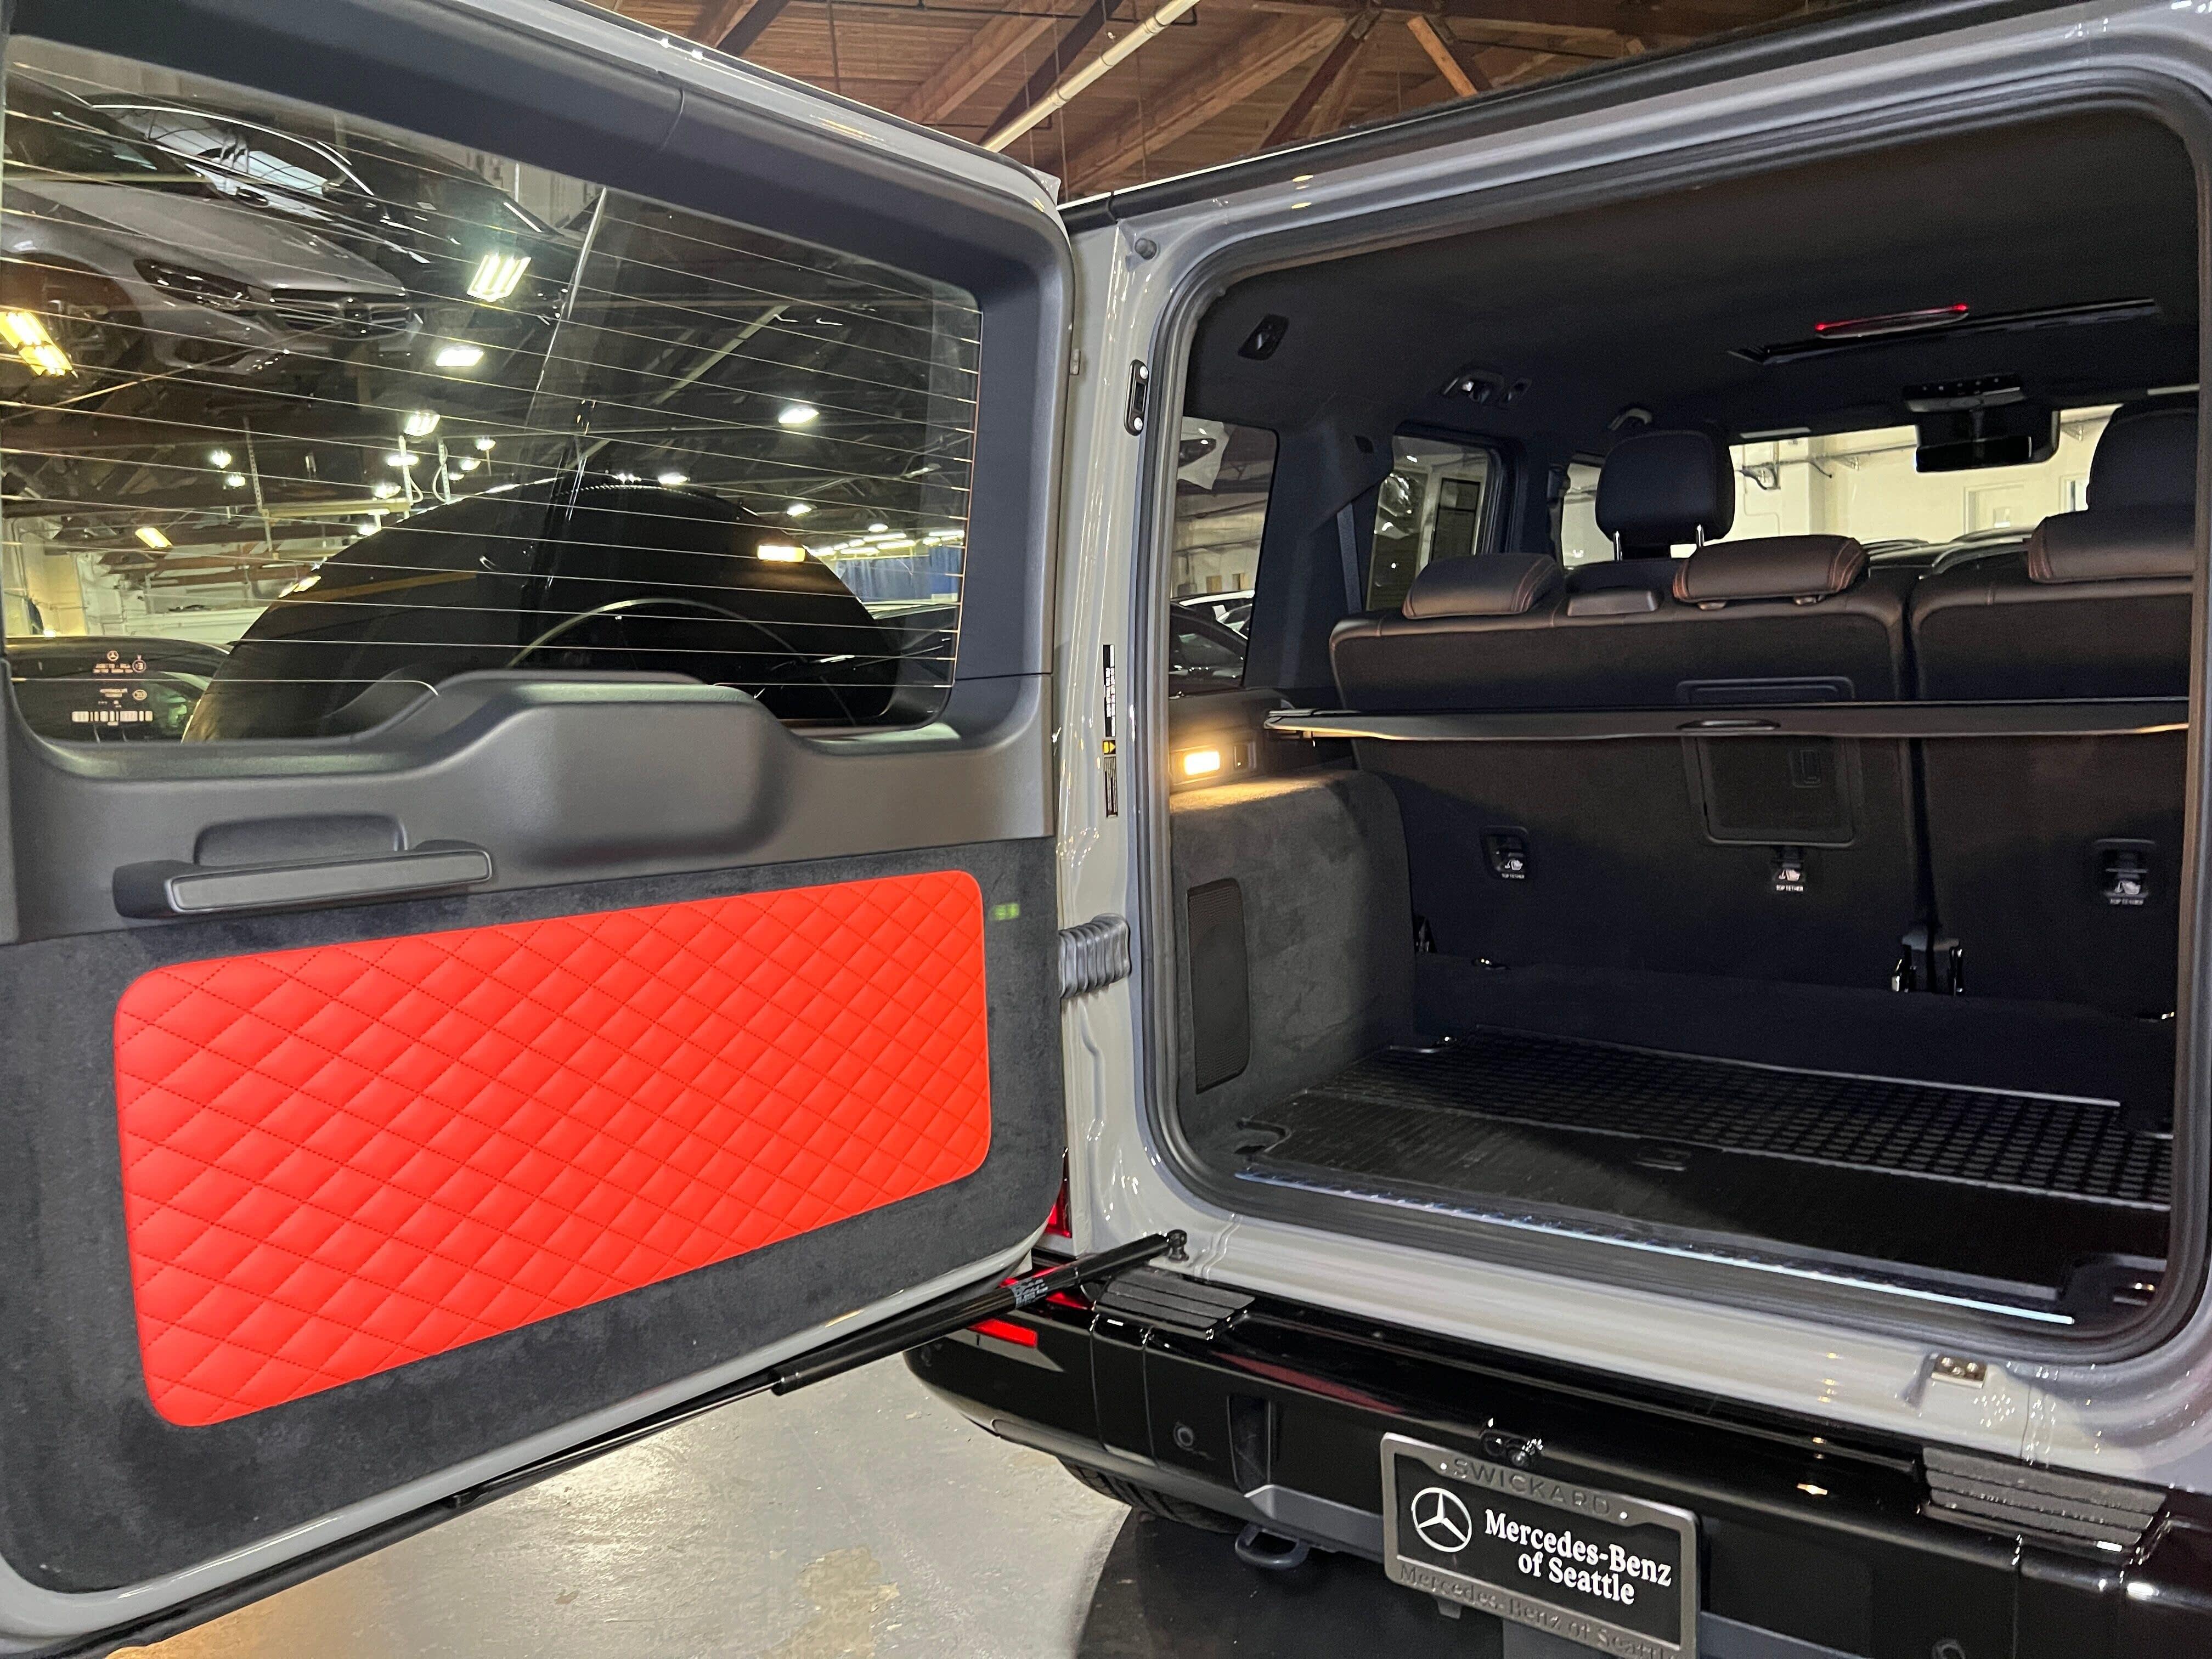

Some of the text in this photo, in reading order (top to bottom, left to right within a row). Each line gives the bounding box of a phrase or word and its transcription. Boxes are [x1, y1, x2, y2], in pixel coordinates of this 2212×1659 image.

[1454, 1458, 1610, 1515] SWICKARD
[1485, 1509, 1672, 1587] Mercedes-Benz
[1518, 1551, 1635, 1605] of Seattle
